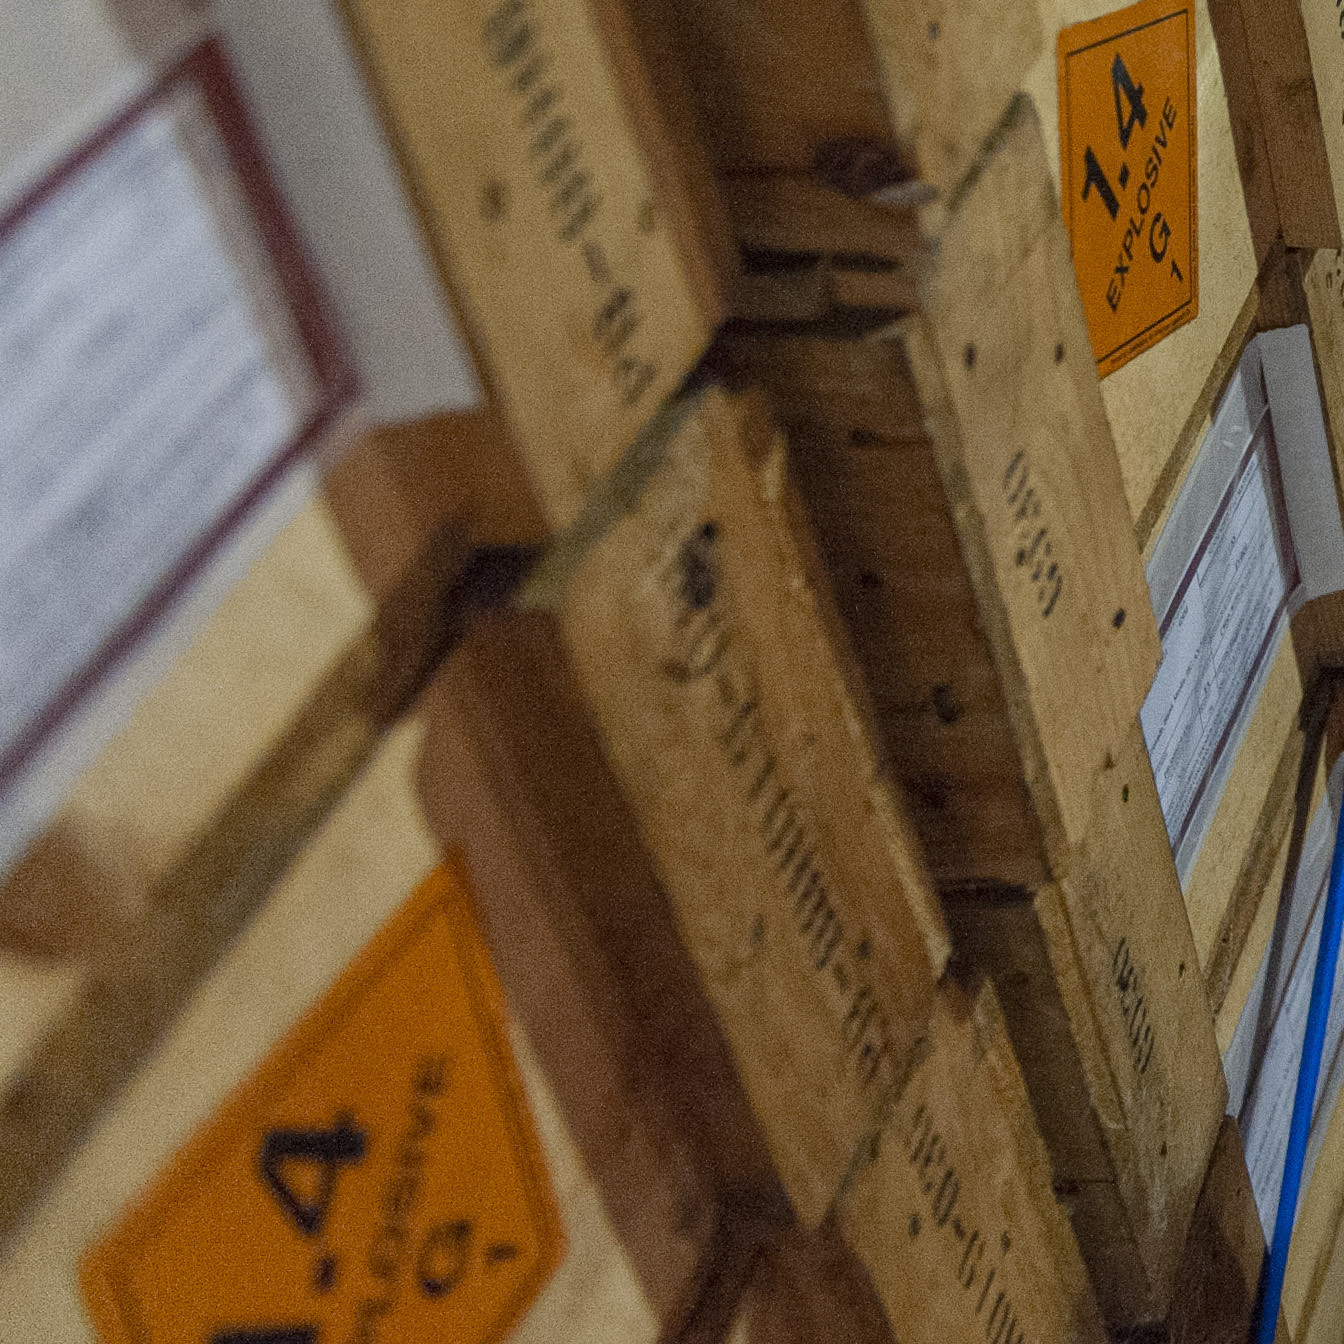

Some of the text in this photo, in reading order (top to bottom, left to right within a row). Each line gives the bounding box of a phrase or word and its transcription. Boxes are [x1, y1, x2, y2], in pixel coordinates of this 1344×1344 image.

[1082, 53, 1148, 221] 1.4
[1104, 96, 1179, 314] EXPLOSIVE
[1147, 211, 1173, 265] G
